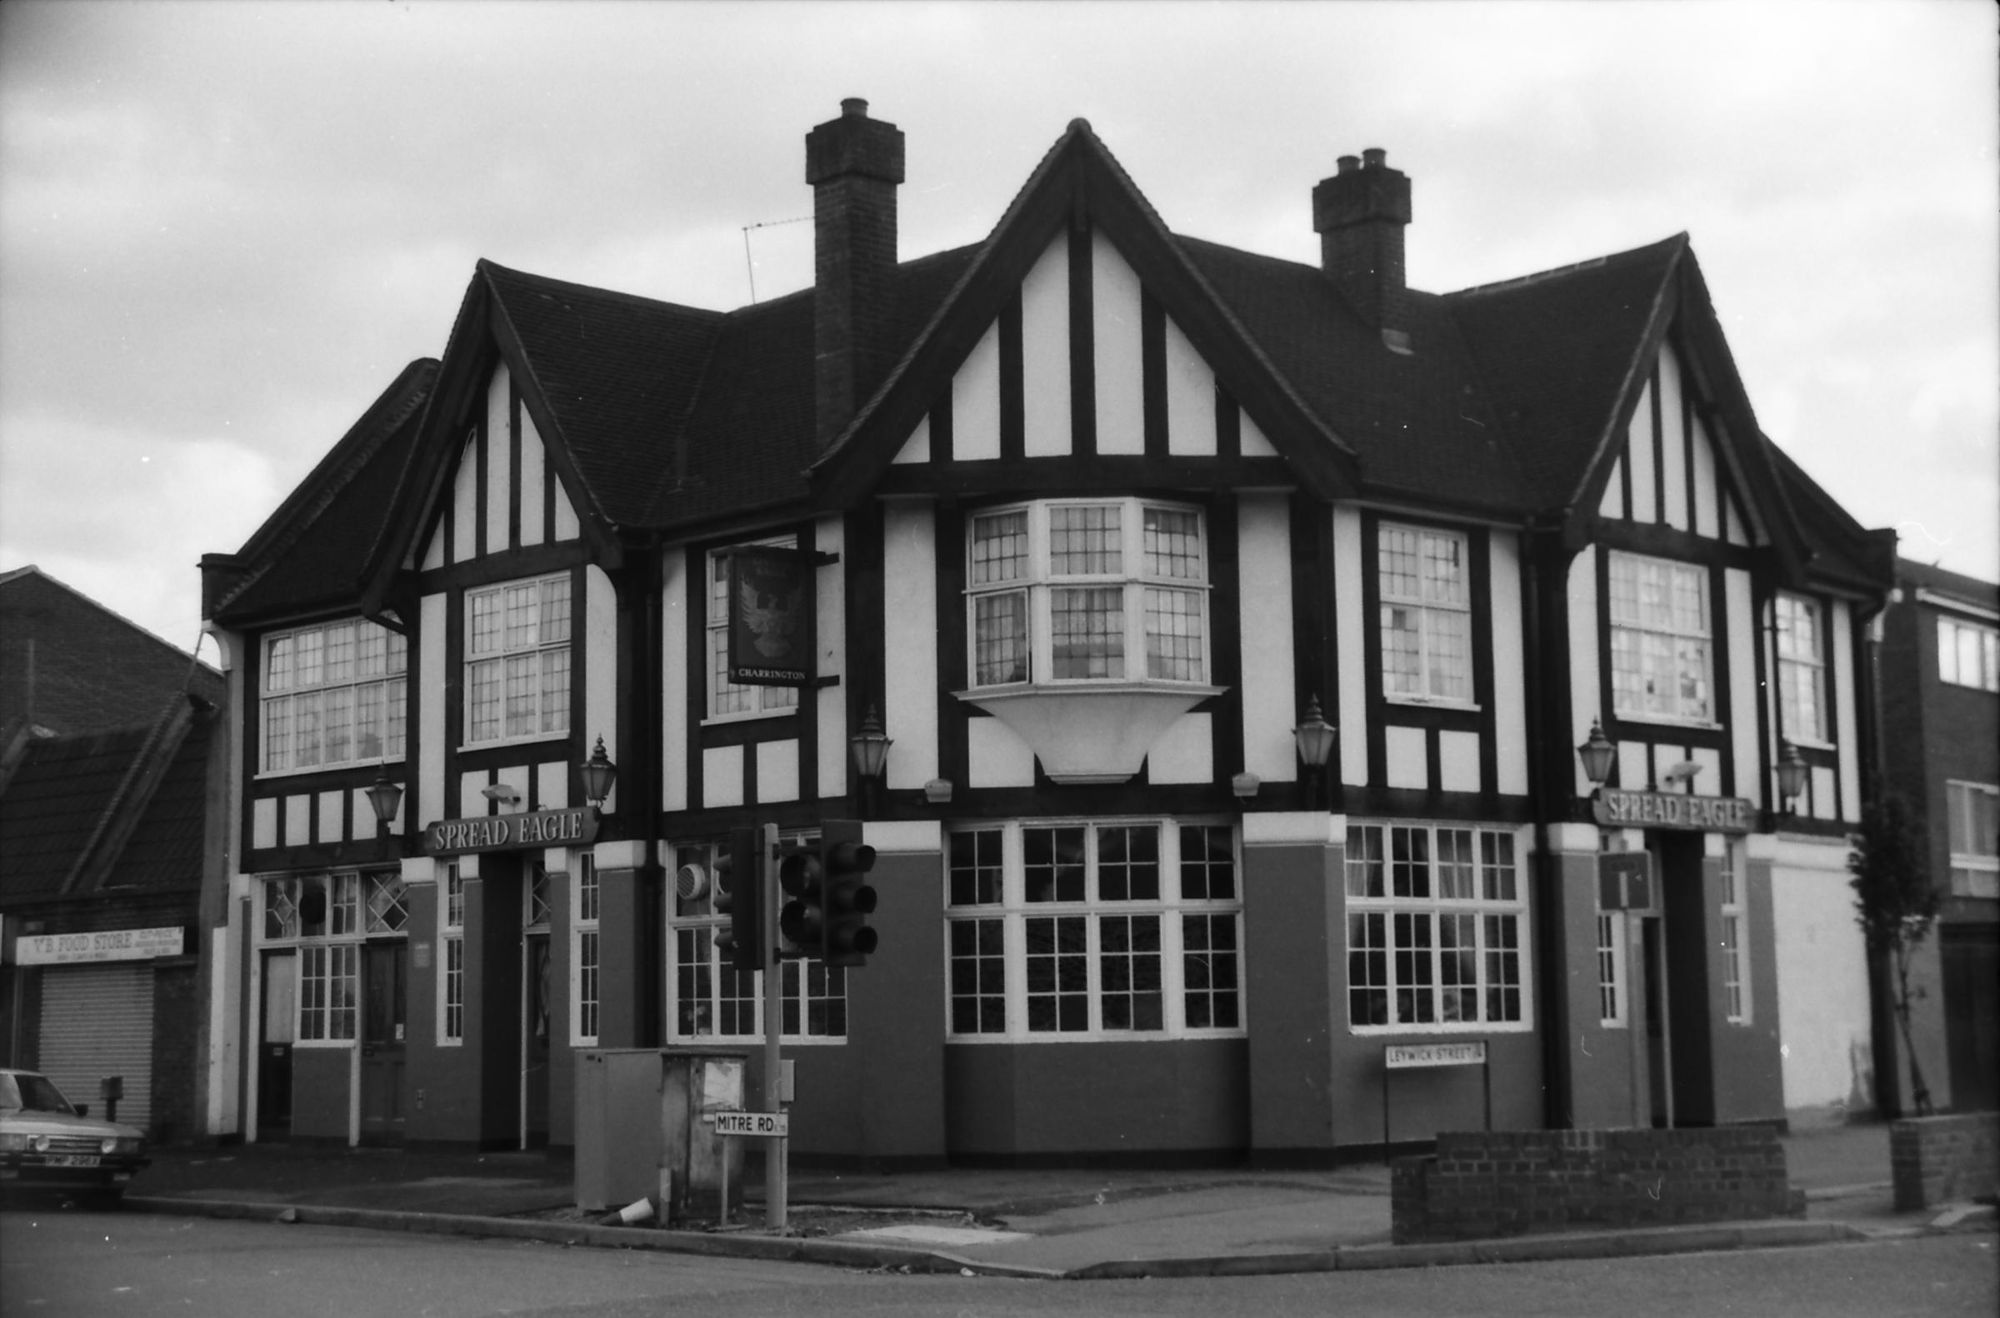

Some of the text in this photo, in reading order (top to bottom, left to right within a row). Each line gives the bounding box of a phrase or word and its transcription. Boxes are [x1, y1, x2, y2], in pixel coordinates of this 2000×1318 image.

[738, 668, 806, 680] CHARRINGTON
[1608, 794, 1747, 827] SPREAD EAGLE
[436, 812, 583, 849] SPREAD EAGLE
[58, 935, 89, 952] FOOD
[94, 932, 133, 949] STORE
[1389, 1049, 1432, 1063] LEYWICK
[1436, 1047, 1472, 1059] STREET
[717, 1116, 752, 1131] MITRE
[758, 1117, 774, 1132] RD
